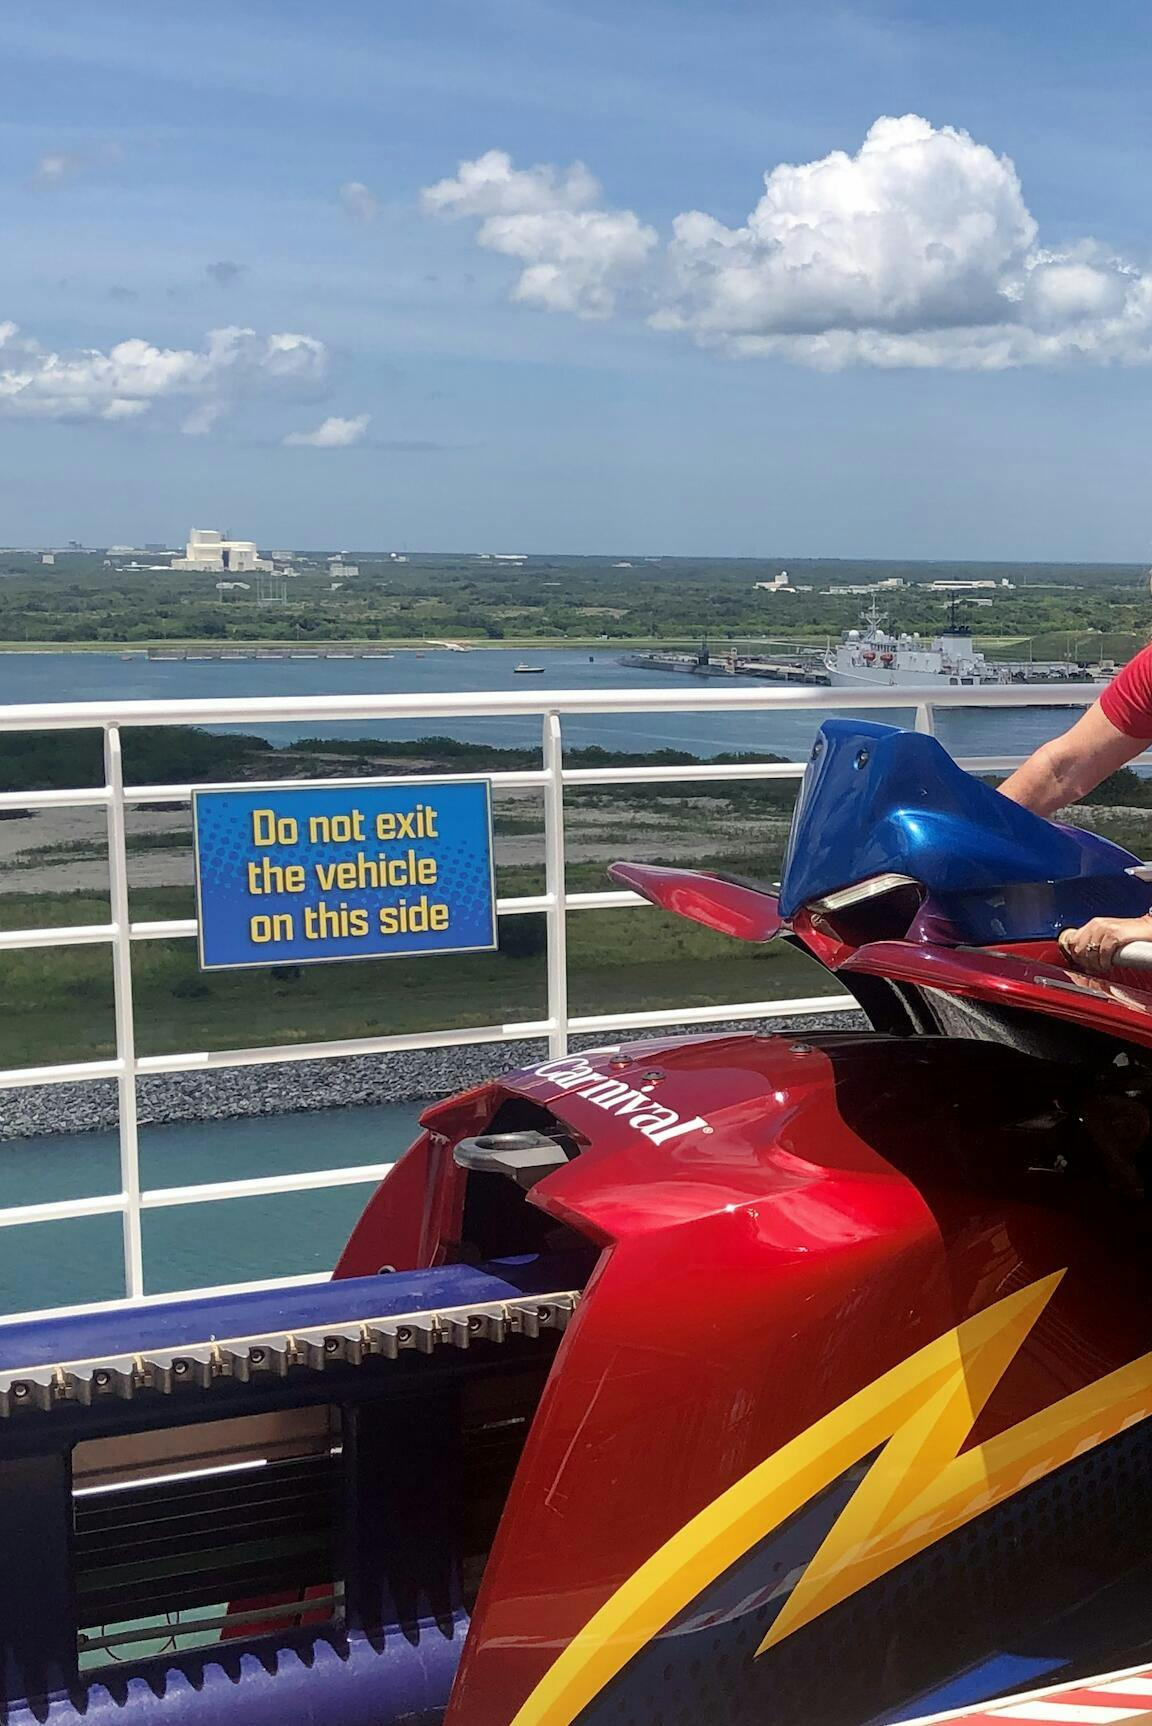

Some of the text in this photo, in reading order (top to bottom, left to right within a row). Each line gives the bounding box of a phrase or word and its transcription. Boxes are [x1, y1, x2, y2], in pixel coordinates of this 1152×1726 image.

[252, 804, 439, 846] Do not exit
[247, 849, 438, 895] the vehicle
[250, 896, 449, 943] on this side
[534, 1057, 709, 1147] Carnival
